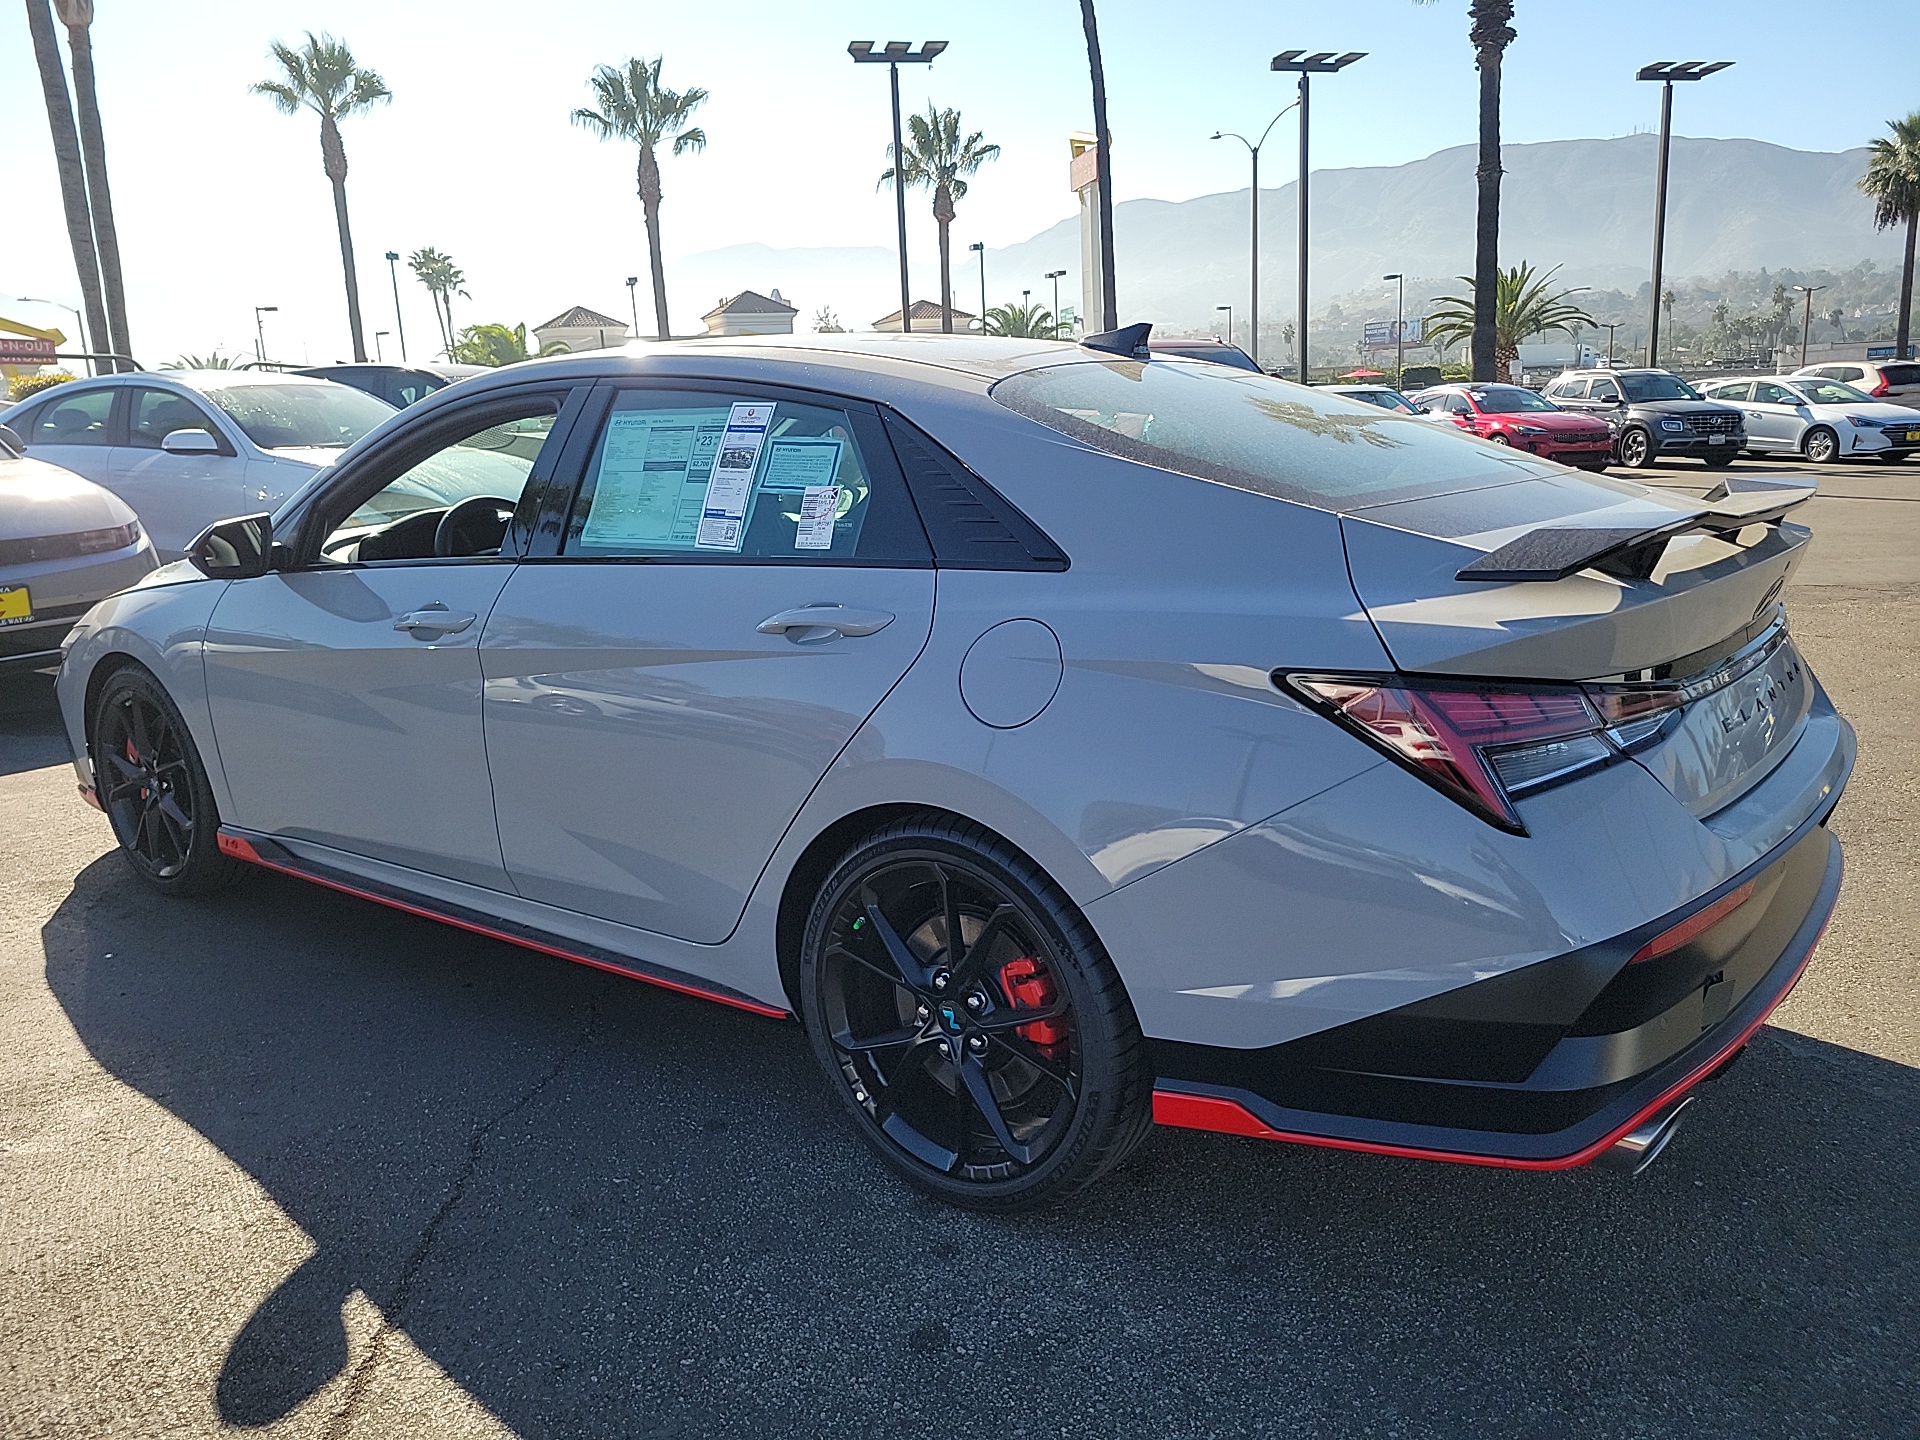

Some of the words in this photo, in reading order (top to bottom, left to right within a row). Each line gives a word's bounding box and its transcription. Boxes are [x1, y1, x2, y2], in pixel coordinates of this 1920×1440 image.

[701, 436, 713, 446] 23
[1721, 661, 1801, 734] ELANTRA
[808, 878, 838, 943] MICHELIN
